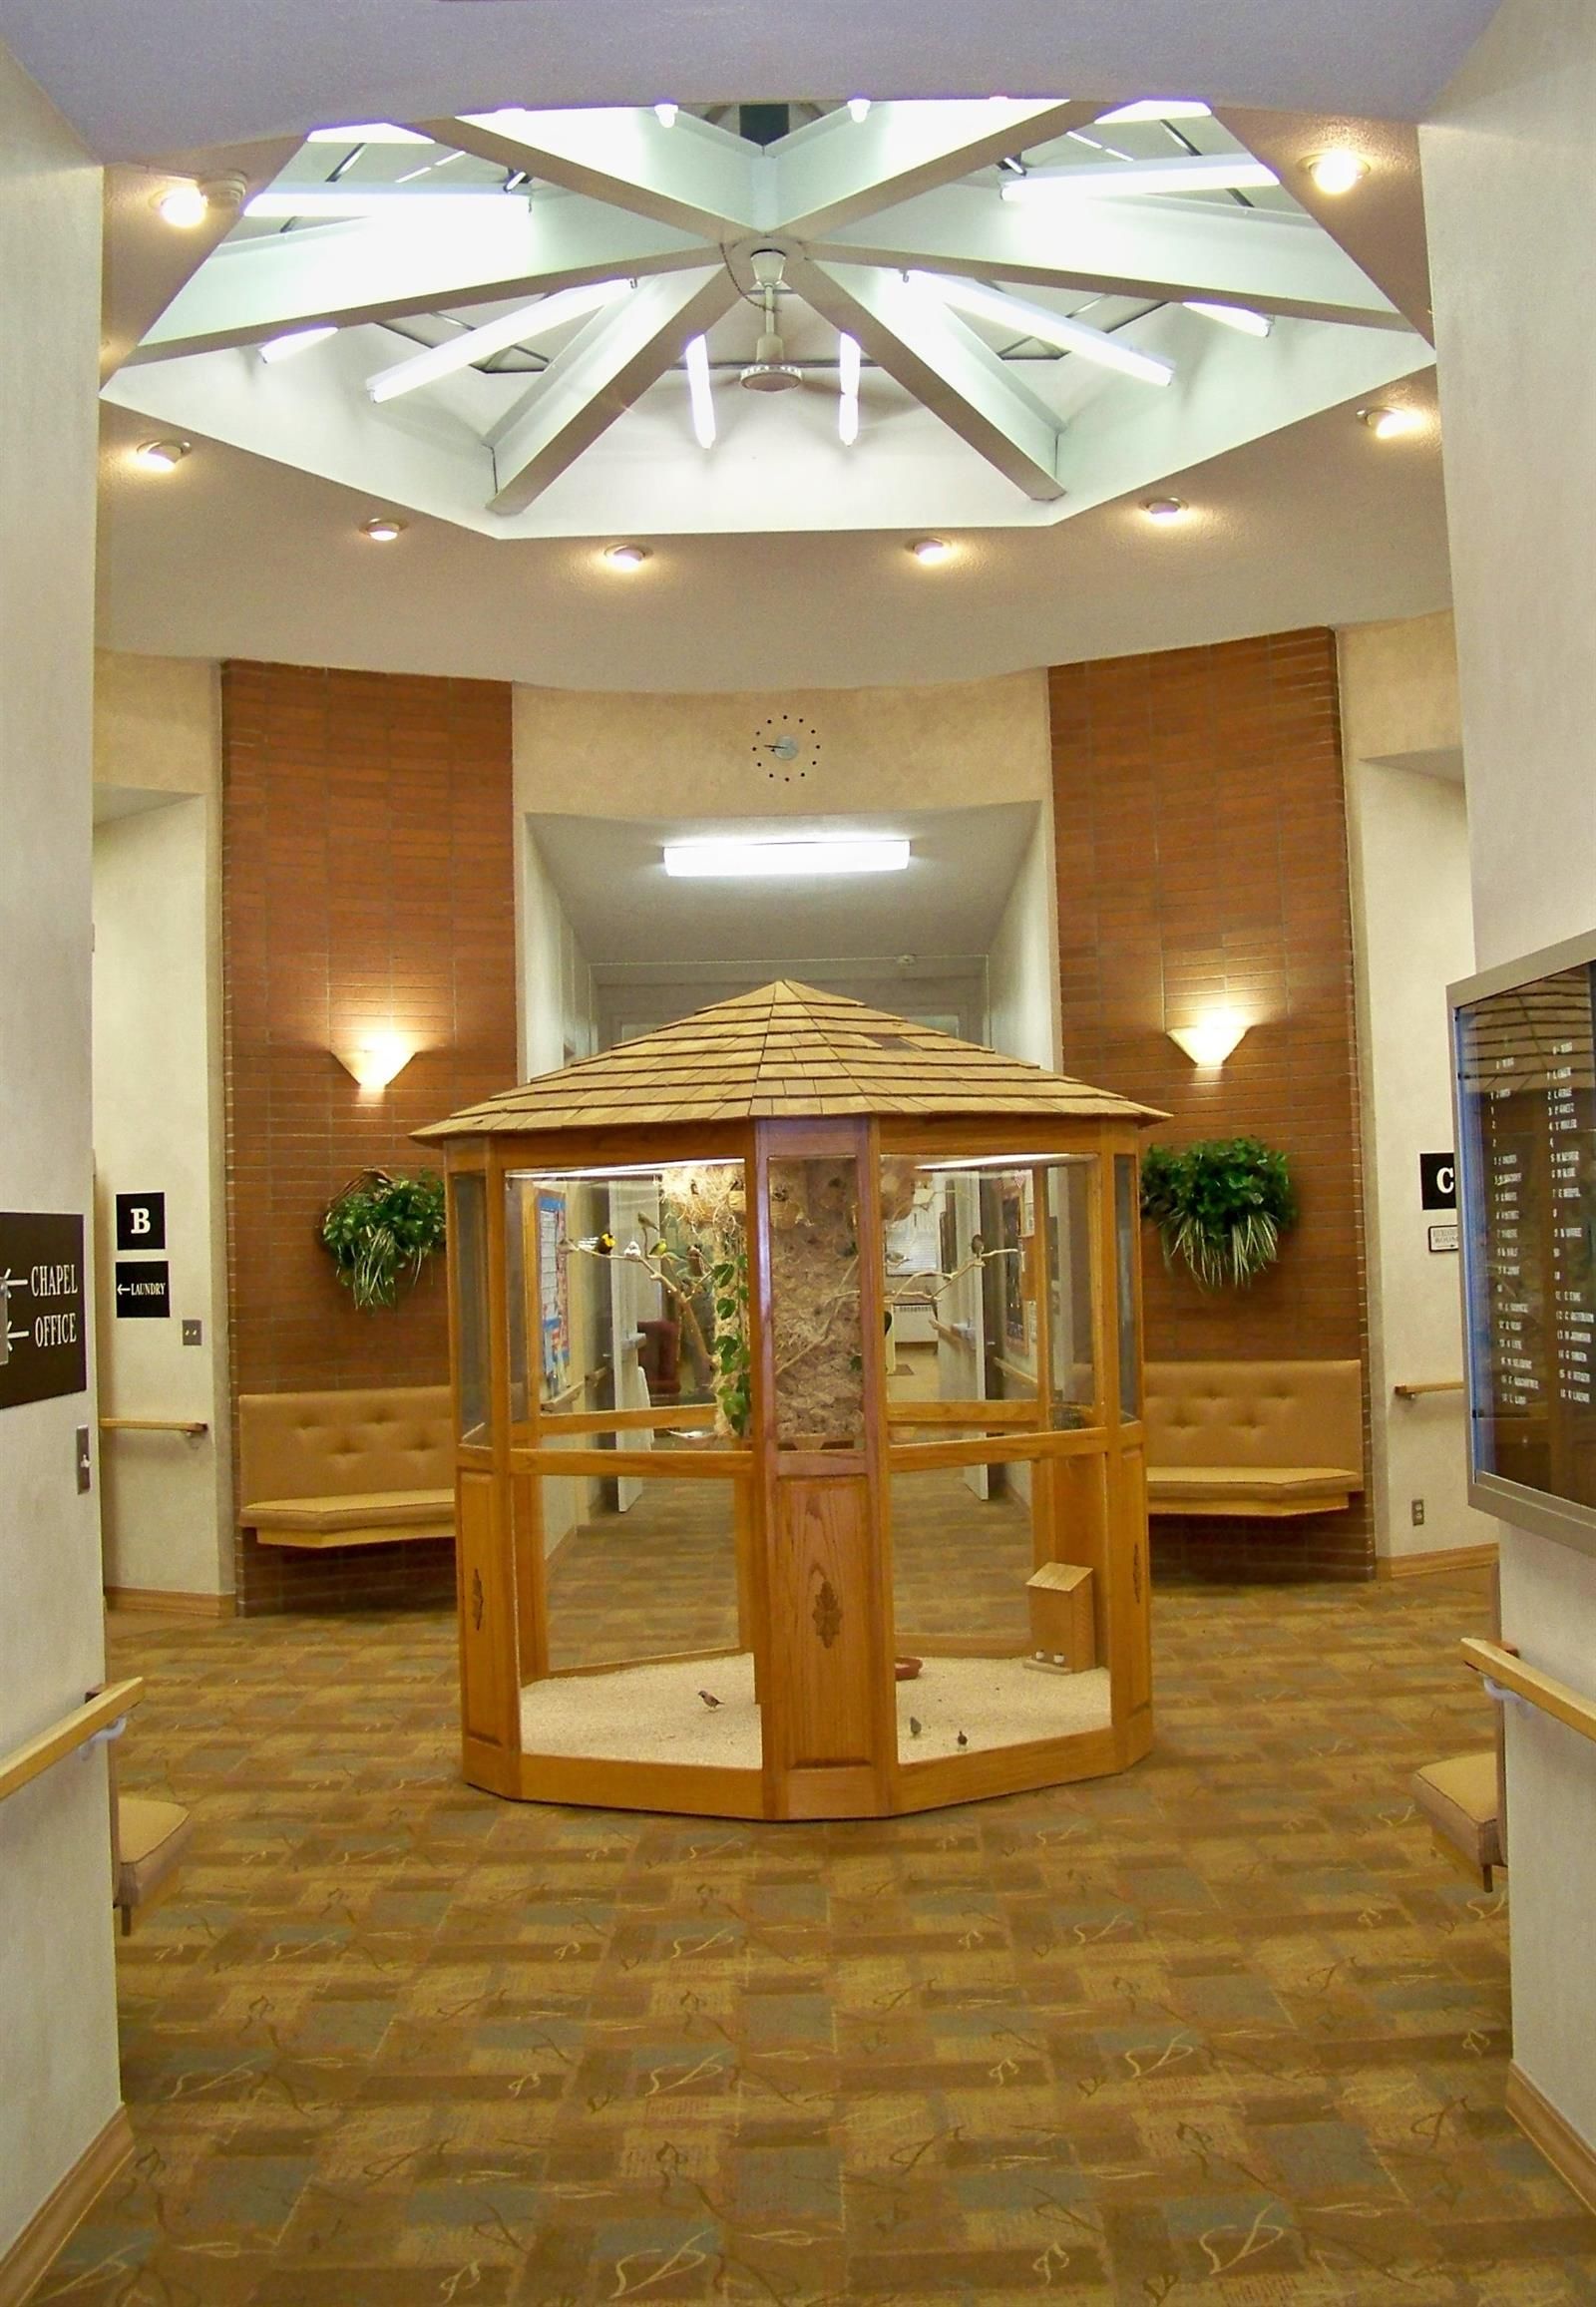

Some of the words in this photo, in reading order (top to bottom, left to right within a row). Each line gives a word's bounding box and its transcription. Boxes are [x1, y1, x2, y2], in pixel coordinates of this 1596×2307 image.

[1436, 1167, 1454, 1193] C
[131, 1208, 151, 1234] B
[31, 1264, 78, 1297] CHAPEL
[131, 1283, 166, 1296] LAUNDRY
[35, 1313, 77, 1347] OFFICE
